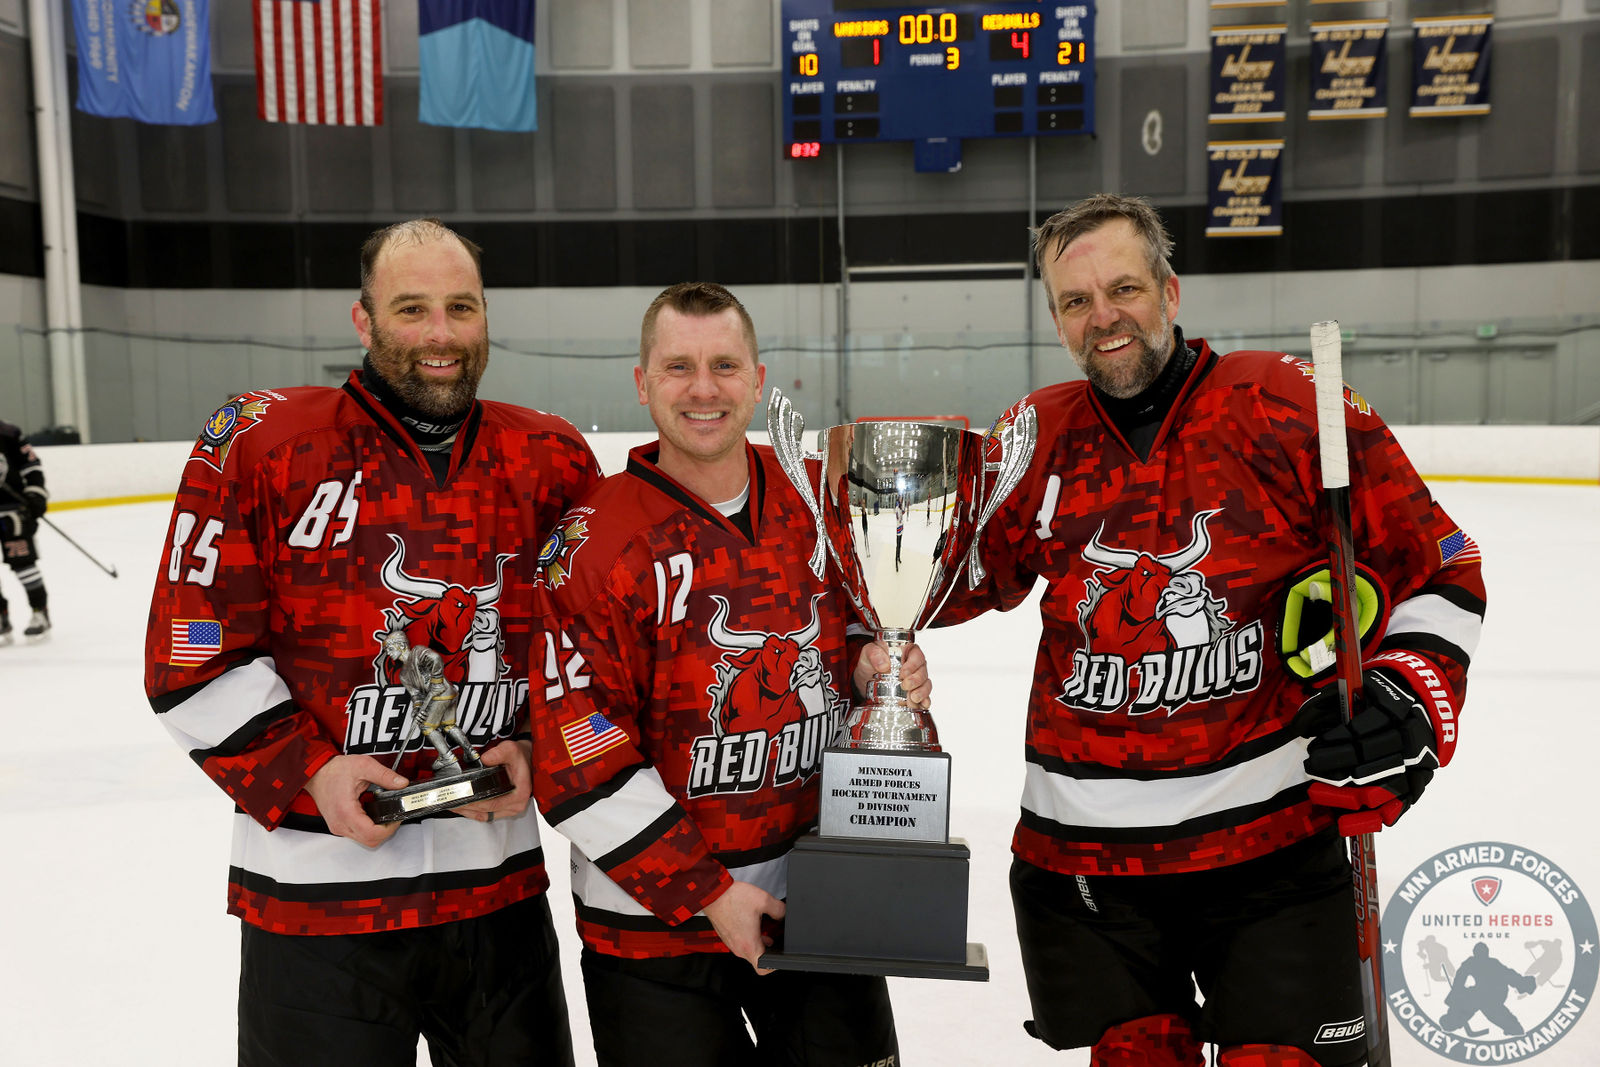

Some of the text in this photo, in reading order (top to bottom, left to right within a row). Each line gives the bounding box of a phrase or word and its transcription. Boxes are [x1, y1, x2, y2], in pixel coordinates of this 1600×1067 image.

[873, 38, 880, 66] 1
[1011, 31, 1030, 58] 4
[1057, 41, 1086, 65] 21
[799, 53, 819, 76] 10
[909, 46, 960, 70] PERIOD 3
[991, 72, 1028, 86] PLAYER
[1039, 70, 1080, 84] PENALTY
[790, 81, 825, 95] PLAYER
[836, 80, 876, 93] PENALTY
[168, 511, 225, 588] 85
[1061, 650, 1128, 711] RED
[1133, 623, 1262, 711] BULLS
[690, 729, 769, 795] RED
[858, 766, 913, 777] MINNESOTA
[849, 778, 921, 789] ARMED FORCES
[831, 789, 937, 802] HOCKEY TOURNAMENT
[858, 802, 910, 813] D DIVISION
[850, 814, 917, 828] CHAMPION
[1350, 835, 1365, 921] SPEED
